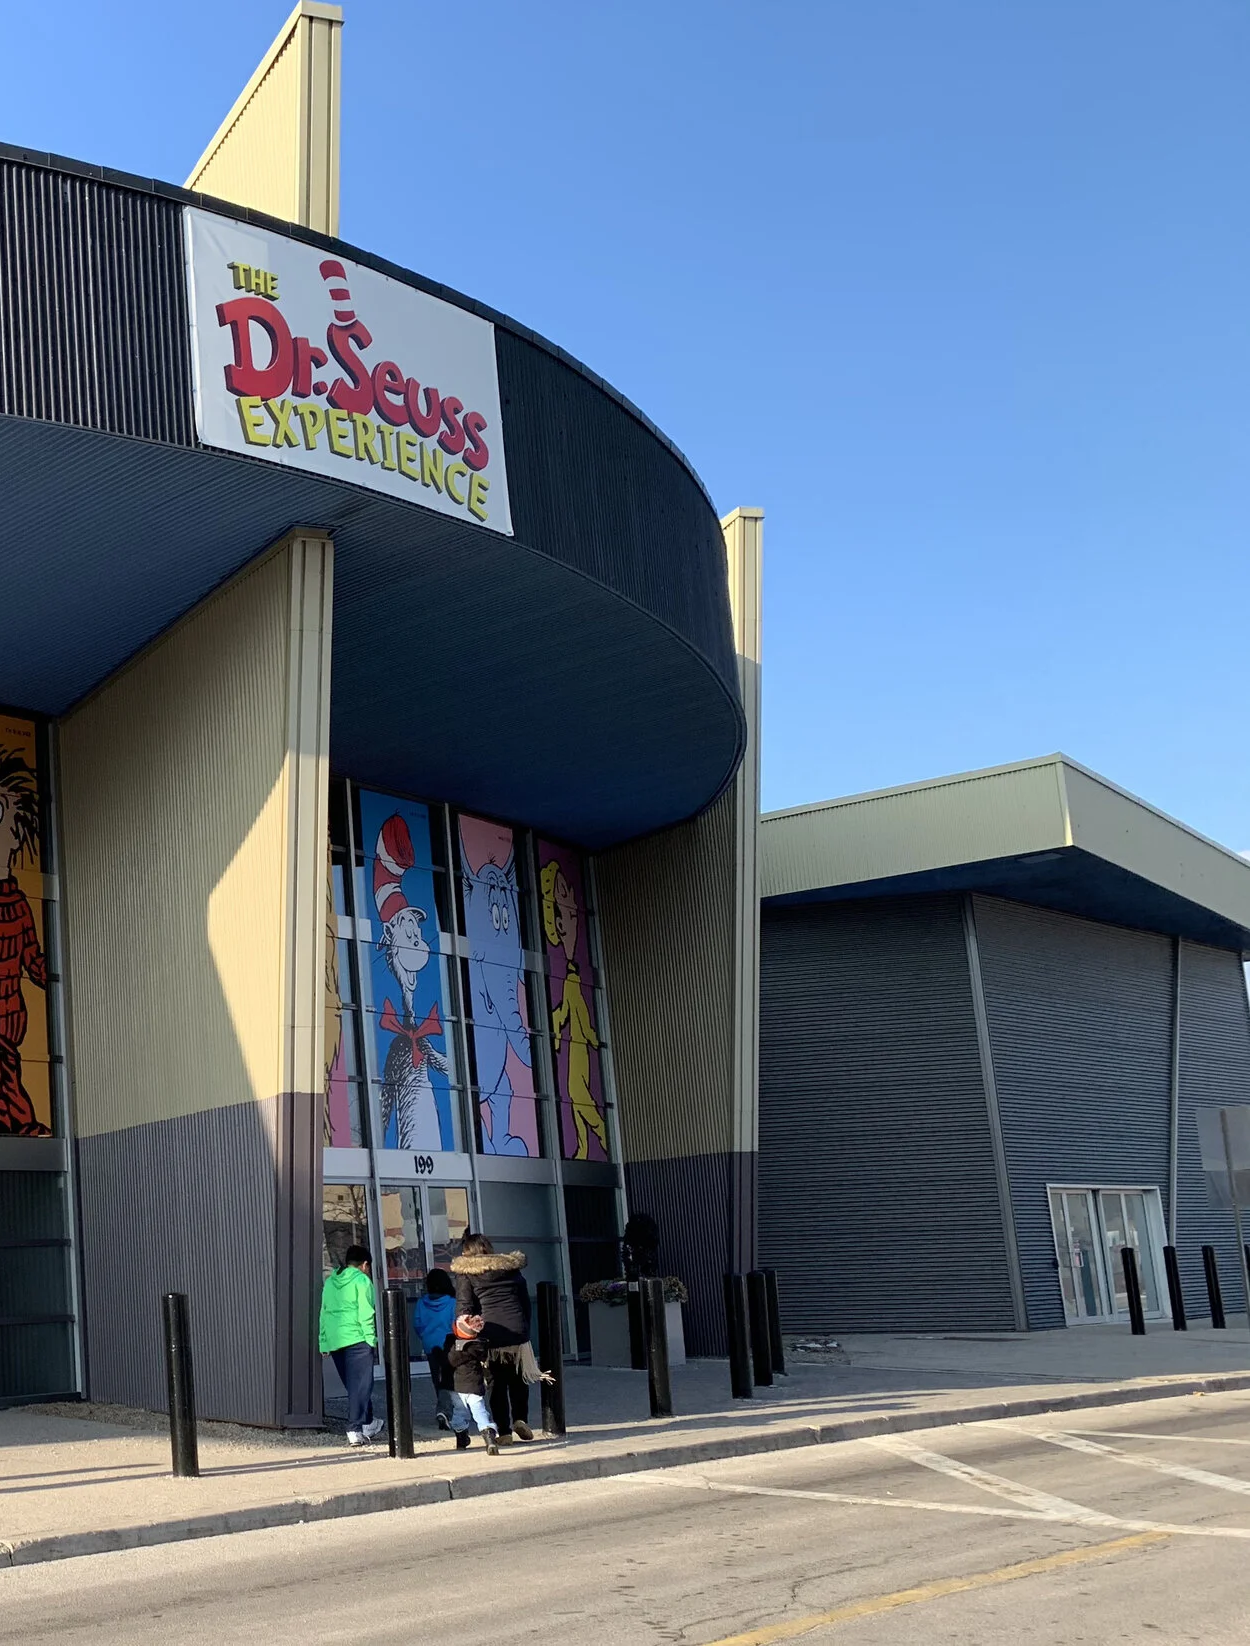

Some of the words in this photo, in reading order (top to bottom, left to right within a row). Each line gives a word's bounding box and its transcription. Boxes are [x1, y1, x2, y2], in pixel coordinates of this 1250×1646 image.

[227, 261, 280, 301] THE
[215, 296, 329, 402] Dr.
[326, 321, 489, 471] Seuss
[235, 396, 490, 522] EXPERIENCE
[414, 1155, 434, 1175] 199
